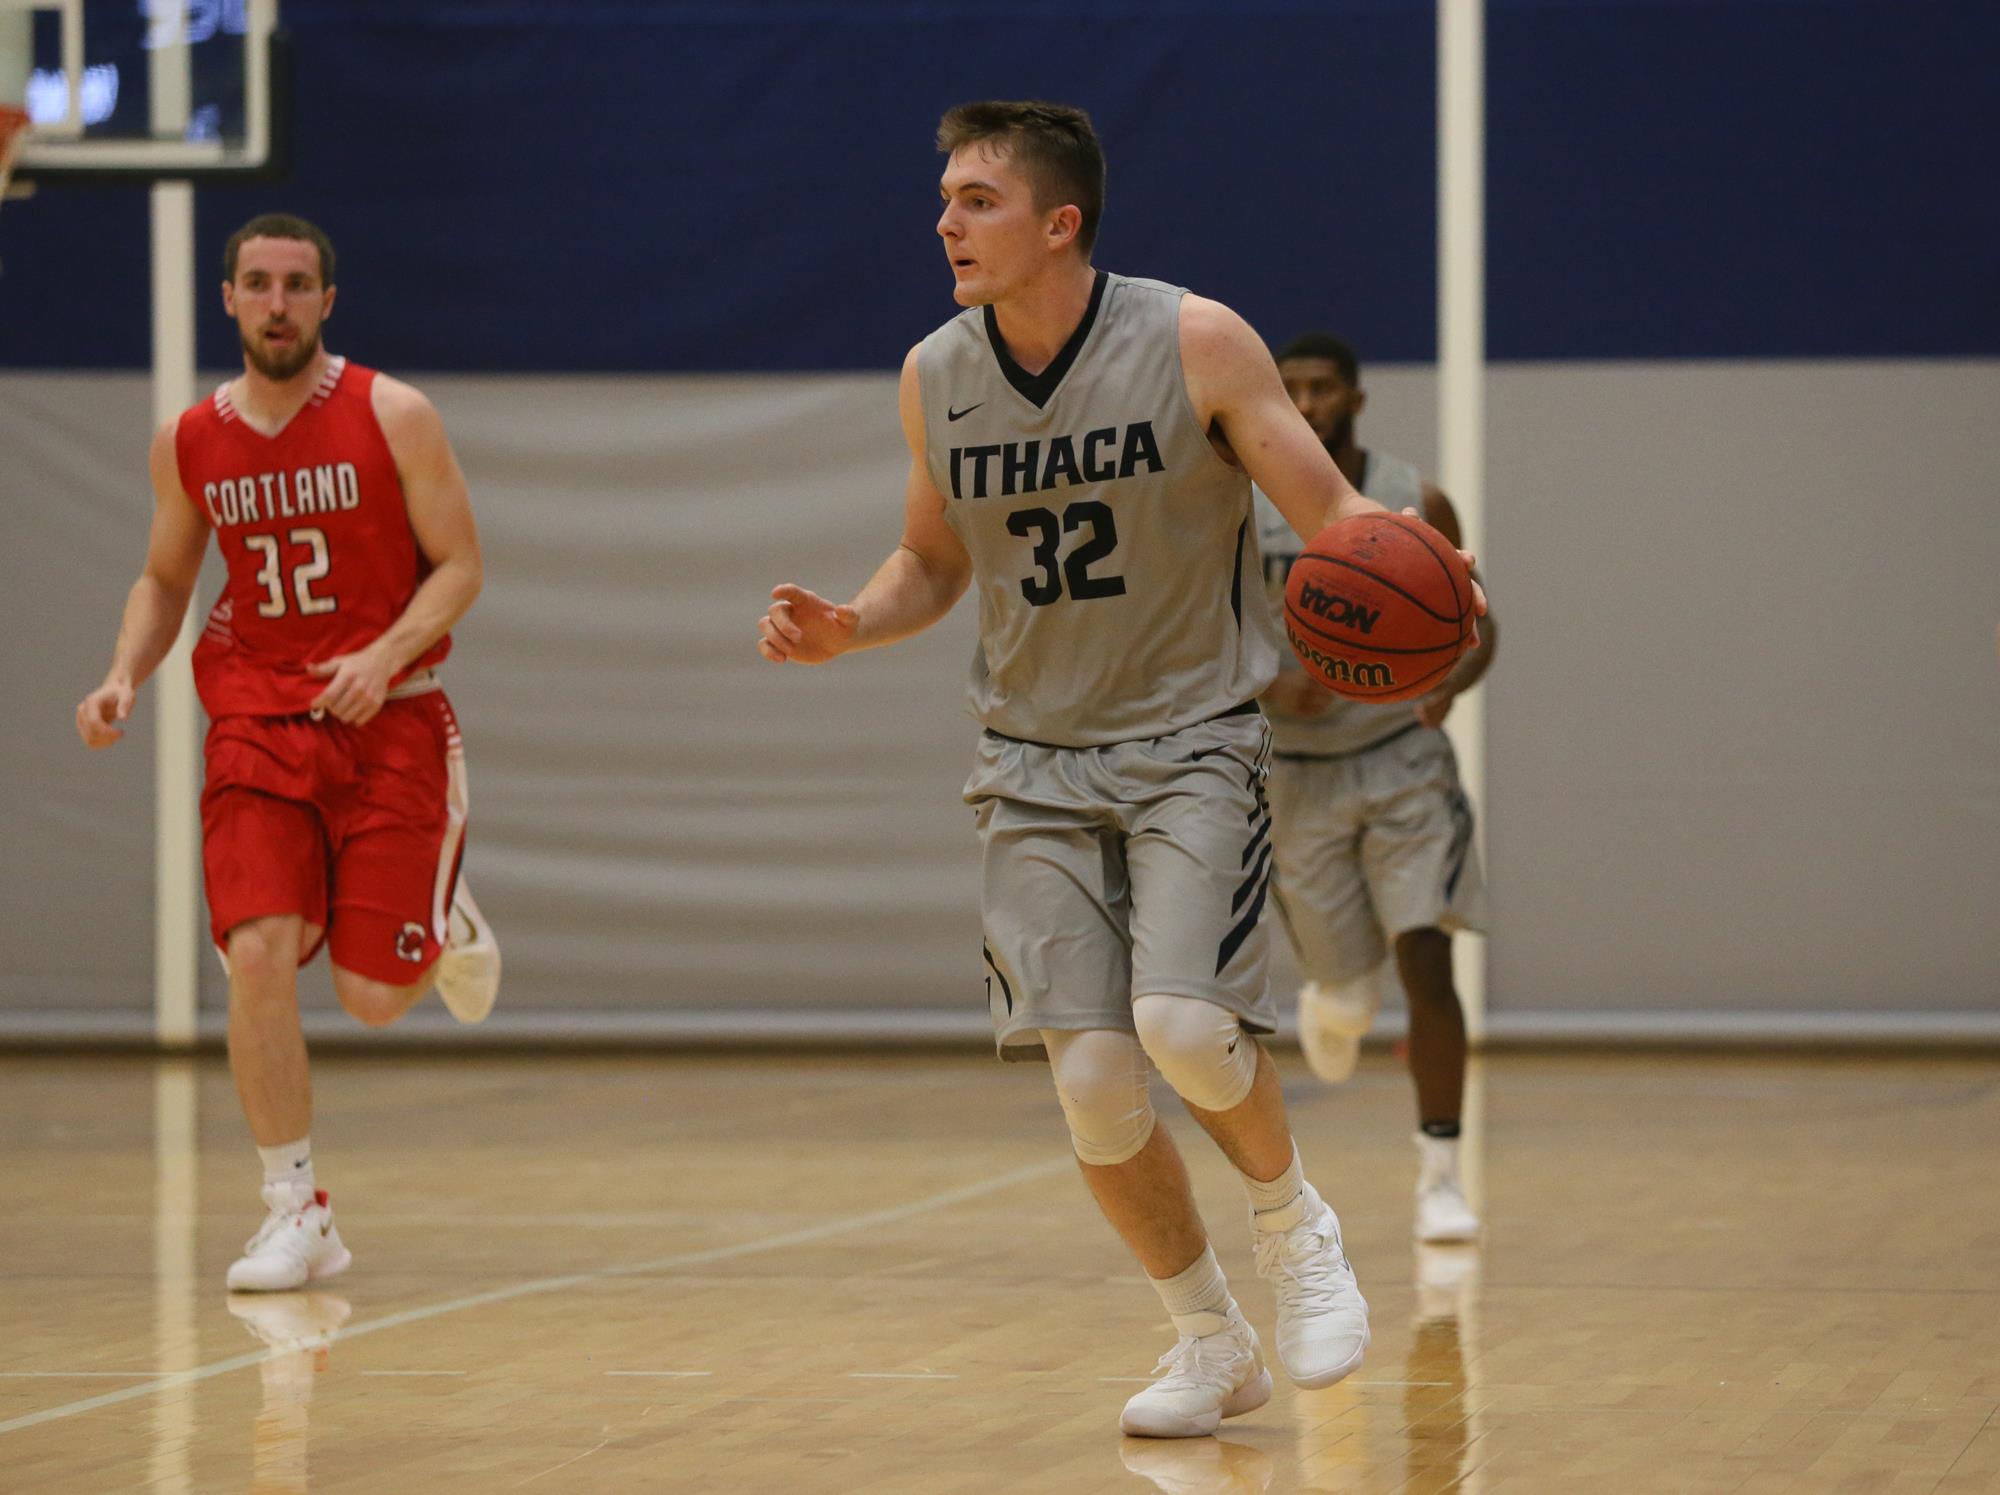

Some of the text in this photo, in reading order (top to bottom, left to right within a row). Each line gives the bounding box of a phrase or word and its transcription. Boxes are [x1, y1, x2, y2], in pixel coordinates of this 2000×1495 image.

[204, 462, 360, 528] CORTLAND
[950, 420, 1165, 499] ITHACA
[245, 527, 338, 619] 32
[1006, 501, 1126, 606] 32
[1300, 581, 1381, 635] NCAA
